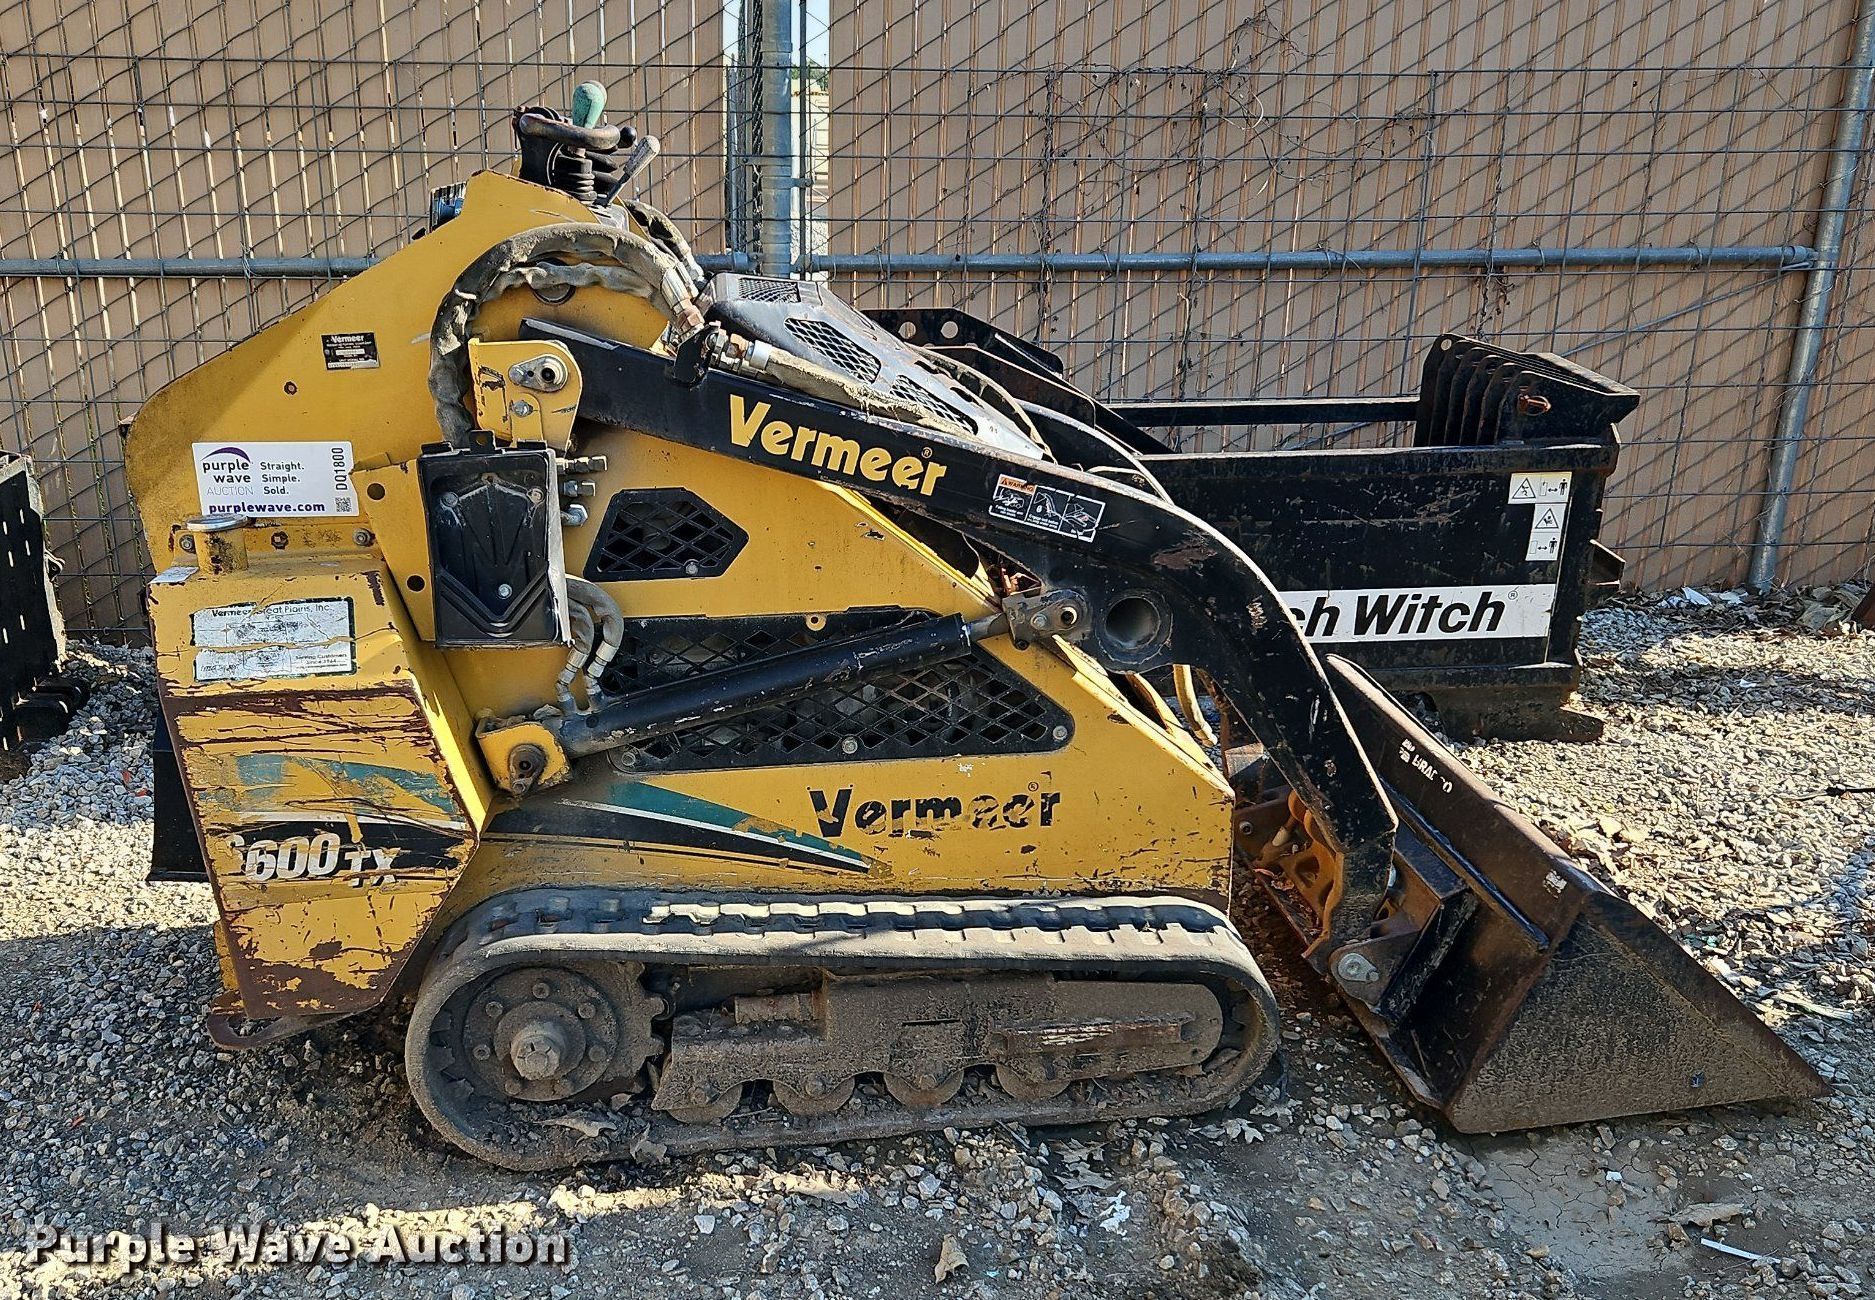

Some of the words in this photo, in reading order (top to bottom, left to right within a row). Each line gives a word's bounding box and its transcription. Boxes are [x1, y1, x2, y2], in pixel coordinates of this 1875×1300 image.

[330, 335, 364, 343] Vermeer
[730, 393, 947, 497] Vermeer
[203, 459, 249, 473] purple
[260, 461, 305, 473] Straight.
[331, 447, 348, 491] DQ1800
[213, 474, 251, 484] wave
[262, 473, 301, 484] Simple.
[206, 486, 254, 496] AUCTION
[263, 486, 289, 495] Sold.
[209, 502, 325, 514] purplewave.com
[1353, 591, 1506, 636] Witch
[808, 788, 1061, 838] Vermeer
